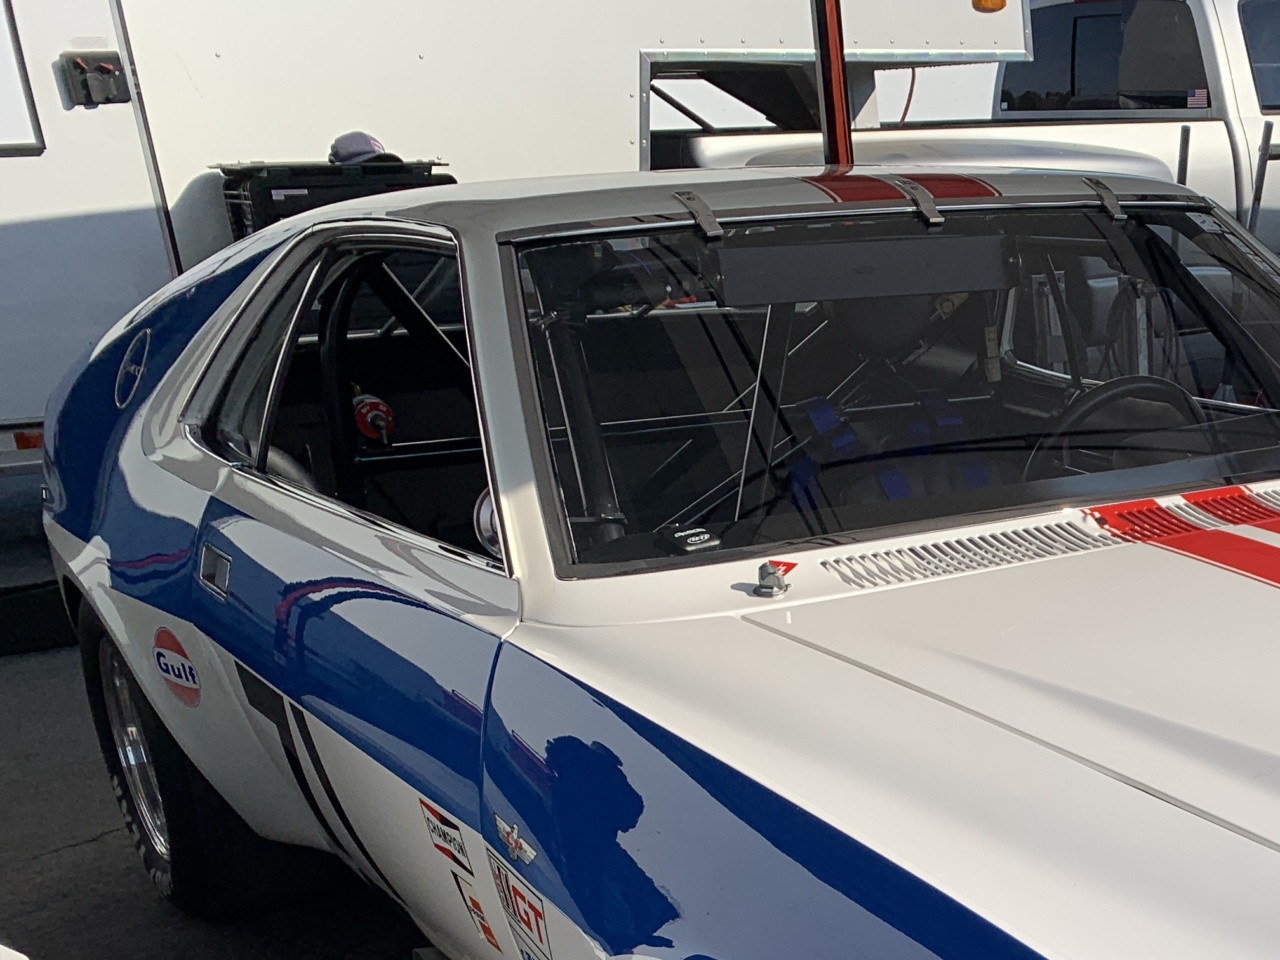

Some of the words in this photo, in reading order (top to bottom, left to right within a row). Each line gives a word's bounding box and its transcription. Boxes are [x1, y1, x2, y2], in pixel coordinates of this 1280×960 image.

[156, 651, 197, 685] Gulf
[427, 817, 467, 858] CHAMPION
[511, 884, 543, 945] GT
